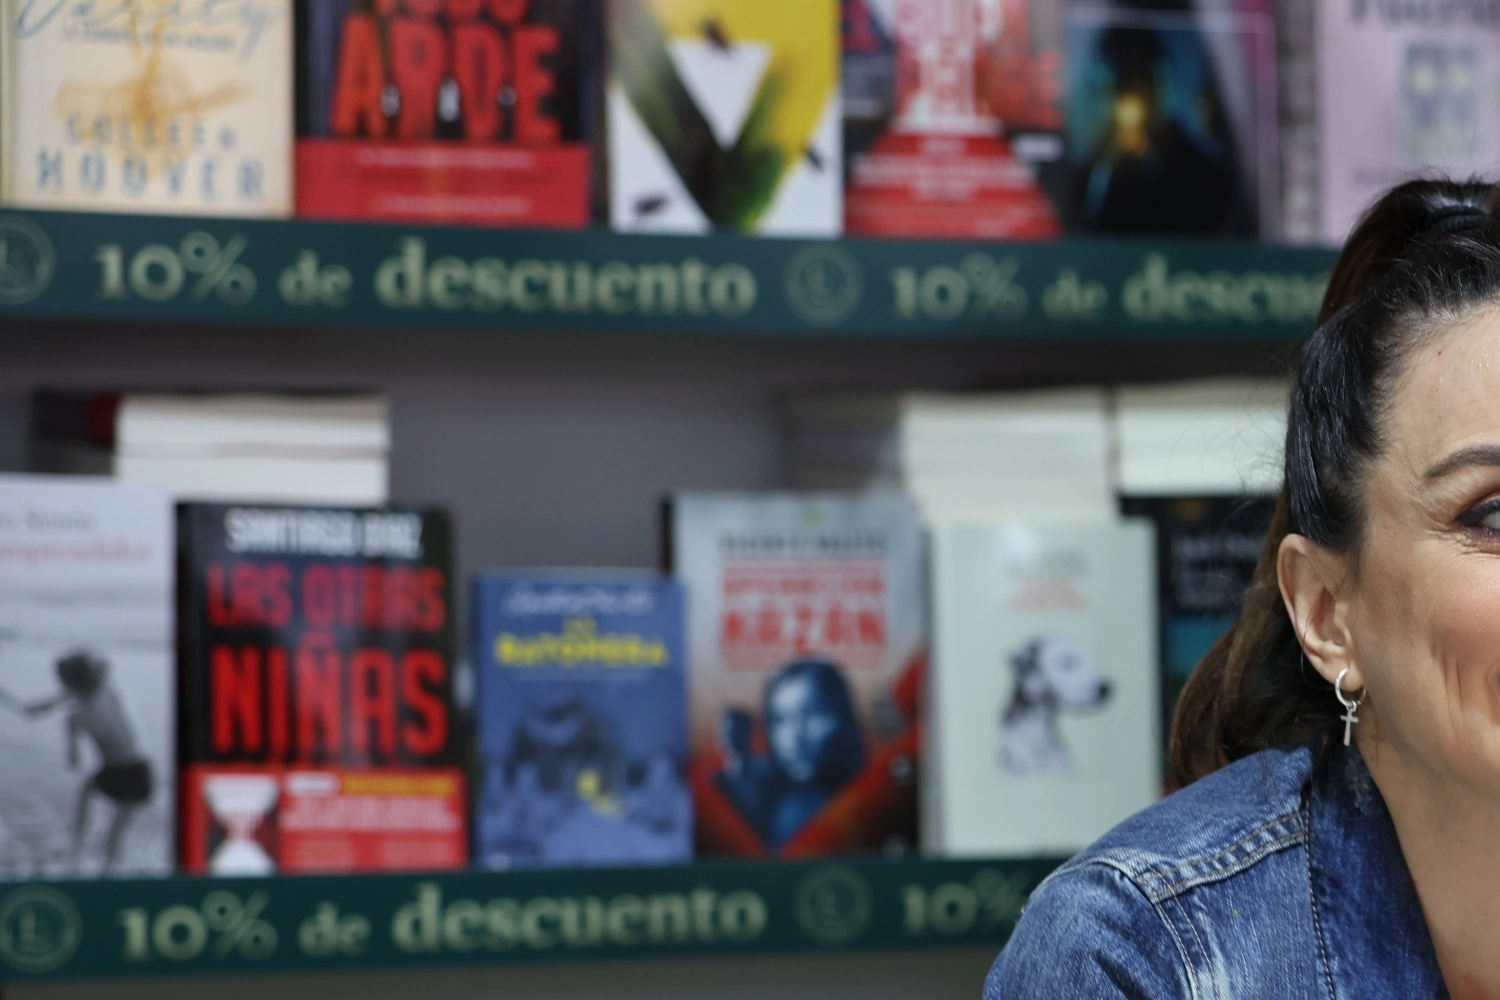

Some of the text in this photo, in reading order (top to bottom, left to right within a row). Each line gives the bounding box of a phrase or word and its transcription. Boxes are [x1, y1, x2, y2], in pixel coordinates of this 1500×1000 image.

[331, 14, 563, 145] ARDE
[37, 149, 266, 201] HOOVER
[93, 231, 757, 317] 10% de descuento
[890, 252, 1028, 322] 10%
[1043, 266, 1109, 320] de
[209, 632, 449, 762] NIÑAS
[117, 883, 768, 962] 10% de descuento
